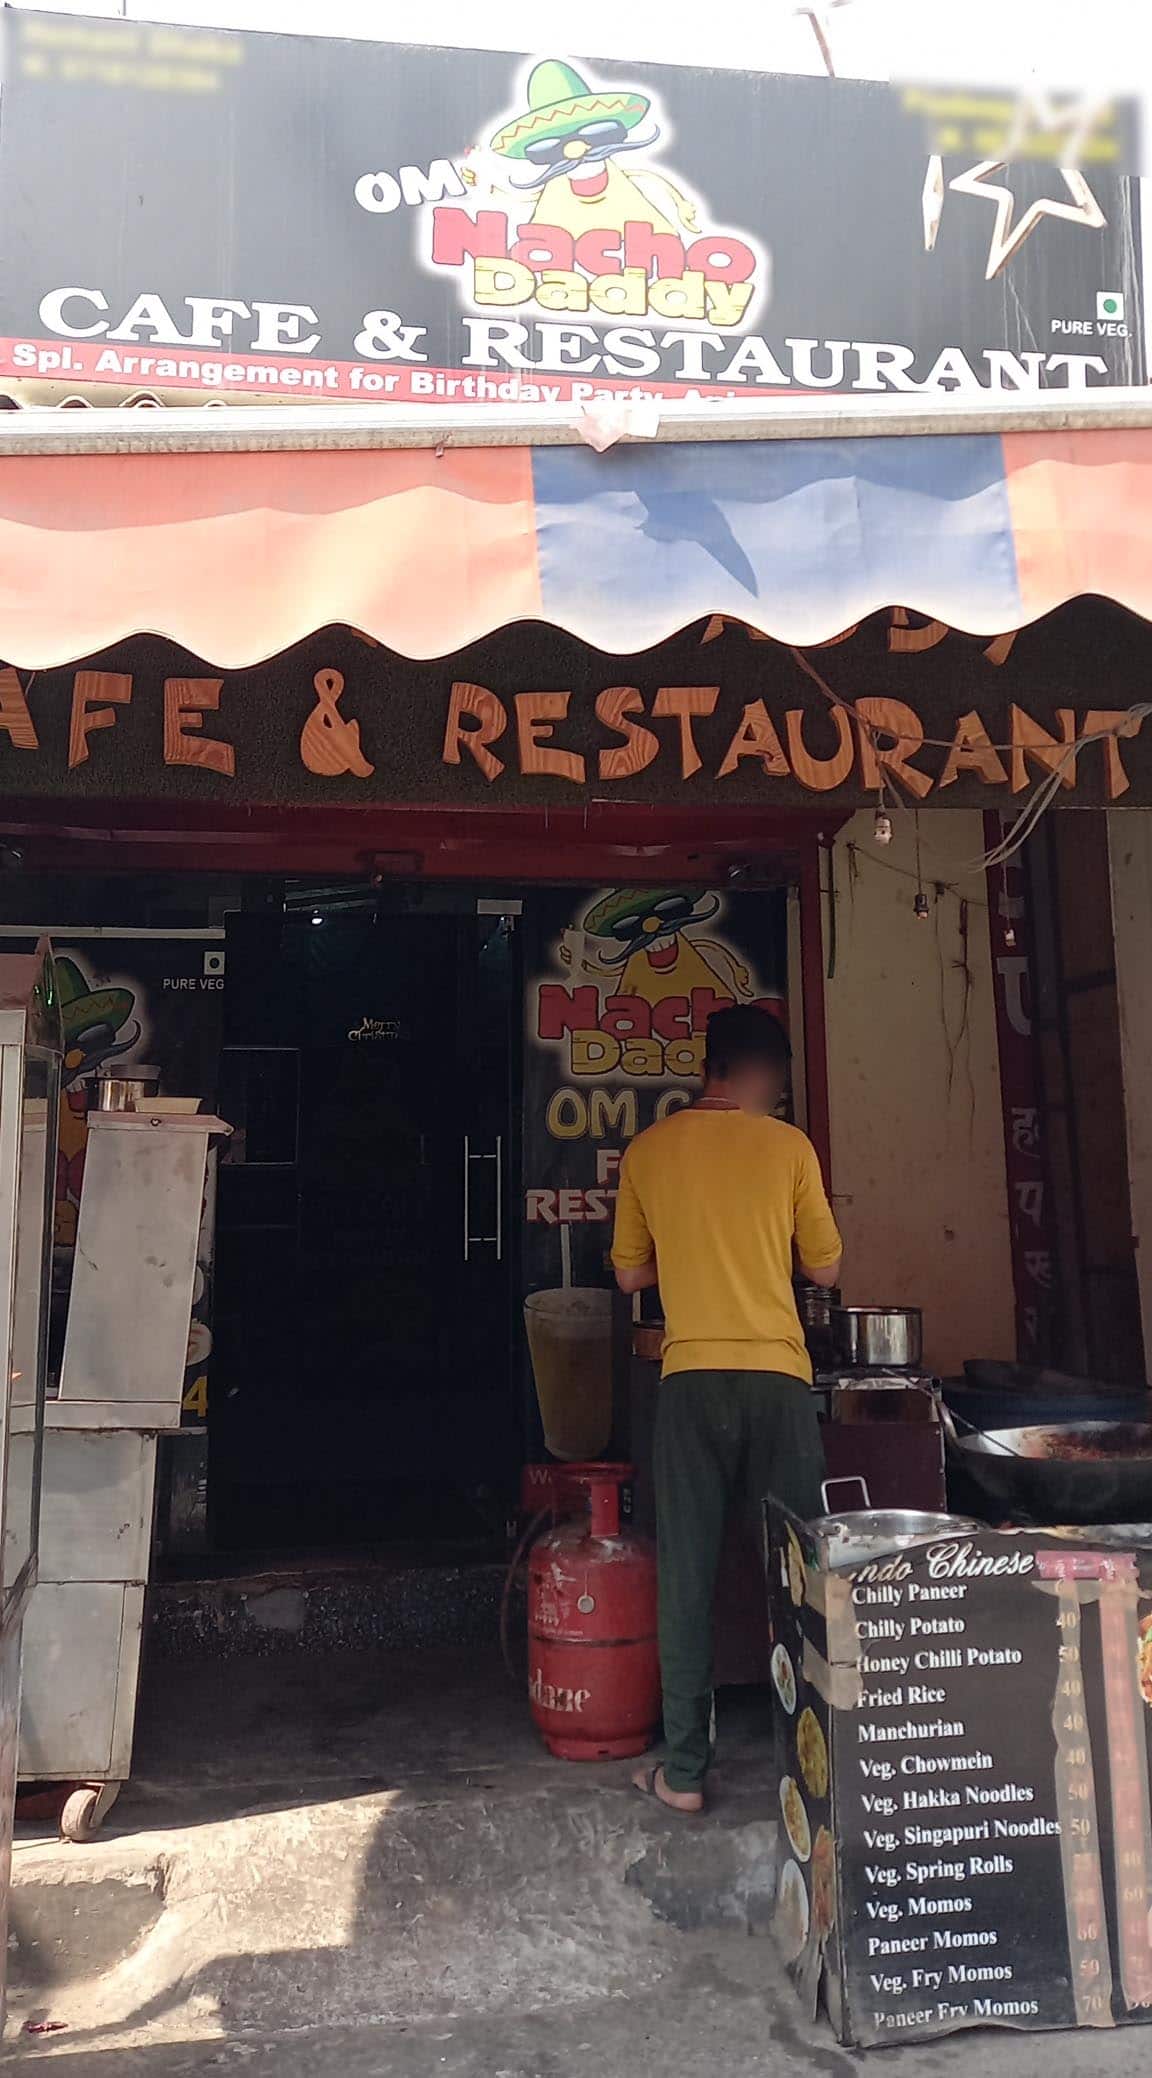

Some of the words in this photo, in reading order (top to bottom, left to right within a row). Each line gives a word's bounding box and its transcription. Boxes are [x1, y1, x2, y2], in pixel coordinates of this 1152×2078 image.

[354, 159, 468, 213] OM
[432, 207, 757, 285] Nacho
[473, 256, 756, 327] Daddy
[38, 287, 322, 354] CAFE
[352, 310, 429, 361] &
[463, 317, 1108, 391] RESTAURANT
[1051, 319, 1093, 335] PURE
[13, 343, 86, 371] Spl.
[95, 350, 339, 390] Arrangement
[350, 367, 399, 392] for
[411, 370, 560, 402] Birthday
[300, 668, 375, 778] &
[442, 681, 1142, 799] RESTAURANT
[162, 978, 196, 990] PURE
[547, 1089, 638, 1139] OM
[926, 1541, 1035, 1580] Chinese
[851, 1585, 903, 1606] Chilly
[908, 1583, 967, 1602] Paneer
[855, 1620, 905, 1641] Chilly
[910, 1617, 965, 1635] Potato
[857, 1655, 909, 1675] Honey
[914, 1650, 962, 1669] Chilli
[967, 1646, 1022, 1665] Potato
[857, 1687, 902, 1709] Fried
[907, 1685, 945, 1704] Rice
[858, 1719, 965, 1743] Manchurian
[859, 1759, 896, 1780] Veg.
[900, 1751, 993, 1775] Chowmein
[861, 1794, 898, 1815] Veg.
[903, 1789, 961, 1810] Hakka
[965, 1783, 1034, 1804] Noodles
[863, 1830, 900, 1851] Veg.
[904, 1822, 989, 1848] Singapuri
[994, 1818, 1062, 1838] Noodles
[1071, 1818, 1090, 1836] 50
[865, 1866, 901, 1887] Veg.
[906, 1860, 964, 1885] Spring
[969, 1855, 1013, 1875] Rolls
[866, 1901, 903, 1922] Veg.
[908, 1895, 972, 1915] Momos
[868, 1936, 928, 1956] Paneer
[933, 1930, 997, 1950] Momos
[870, 1973, 907, 1994] Veg.
[911, 1968, 943, 1989] Fry
[948, 1964, 1012, 1983] Momos
[873, 2009, 932, 2030] Paneer
[973, 1998, 1038, 2018] Momos
